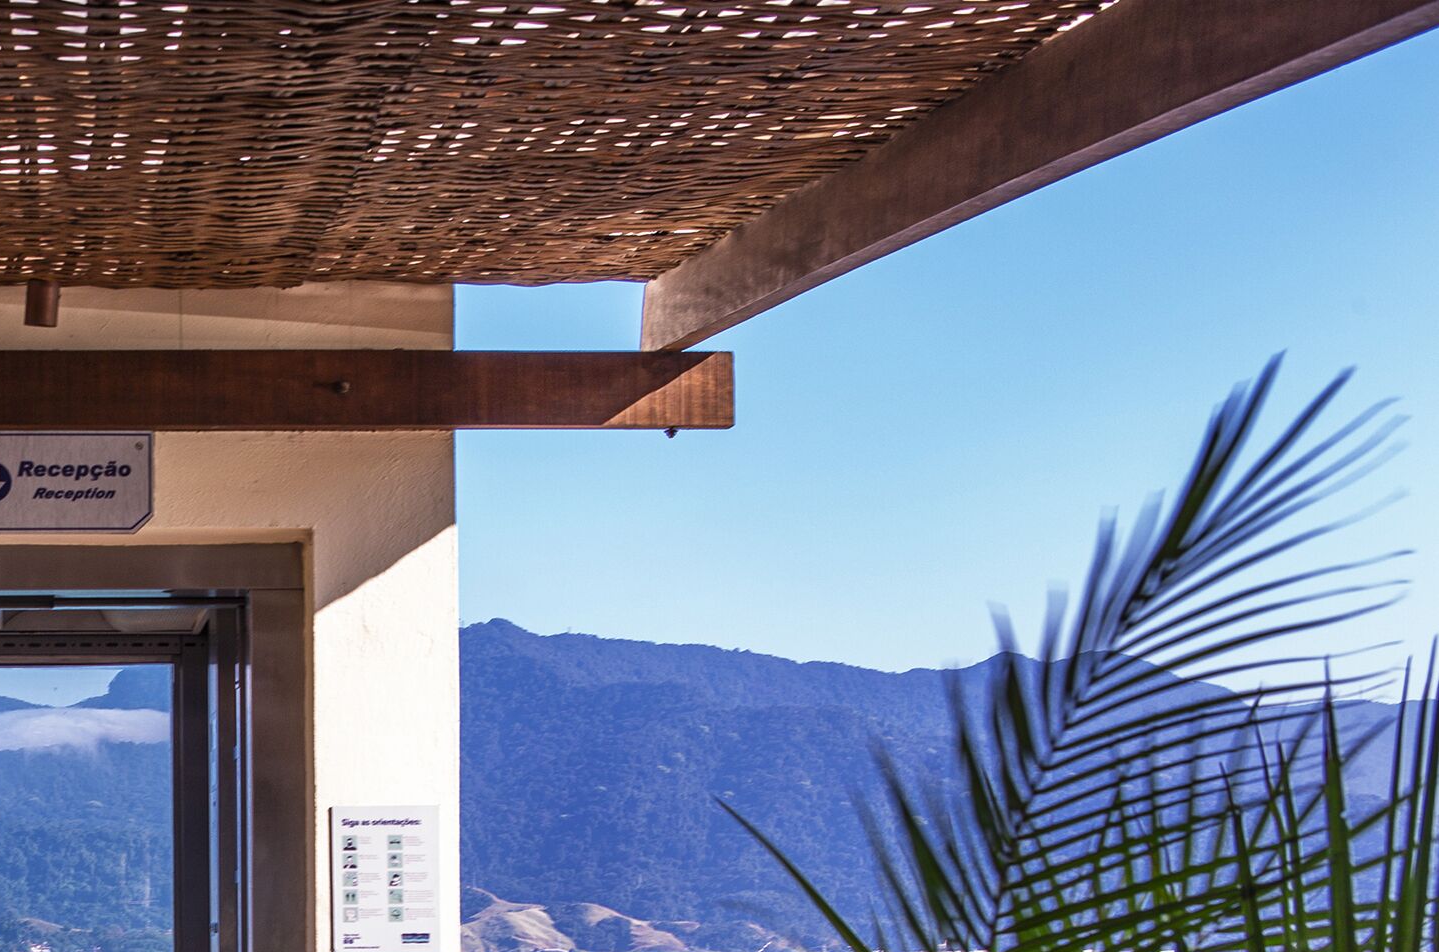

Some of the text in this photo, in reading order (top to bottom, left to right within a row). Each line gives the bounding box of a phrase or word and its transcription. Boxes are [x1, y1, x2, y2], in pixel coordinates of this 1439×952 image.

[17, 461, 132, 481] Recepção
[32, 487, 116, 501] Reception
[342, 818, 359, 828] Siga
